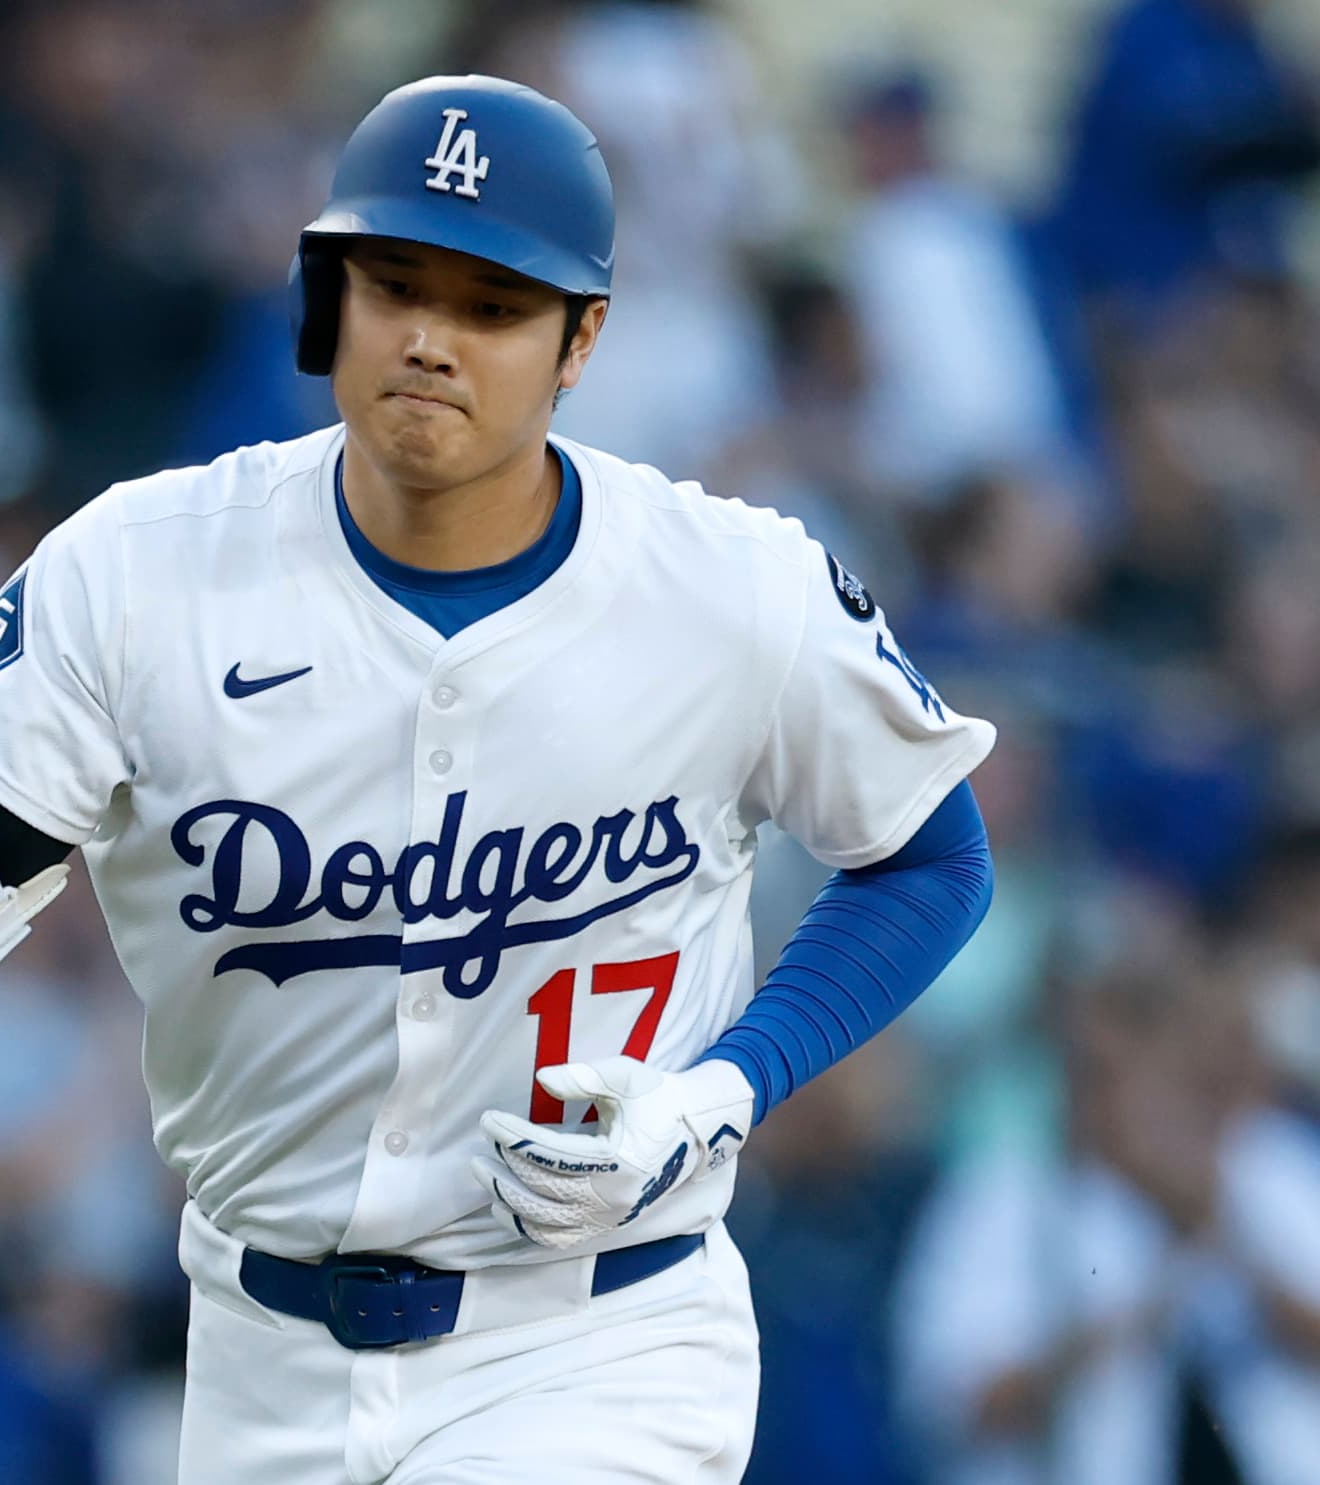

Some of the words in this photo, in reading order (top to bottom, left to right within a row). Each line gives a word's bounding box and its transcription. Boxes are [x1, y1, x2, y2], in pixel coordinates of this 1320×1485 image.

[424, 108, 490, 198] LA
[170, 790, 700, 1000] Dodgers
[527, 951, 680, 1125] 17
[526, 1151, 555, 1168] new
[559, 1160, 618, 1173] balance
